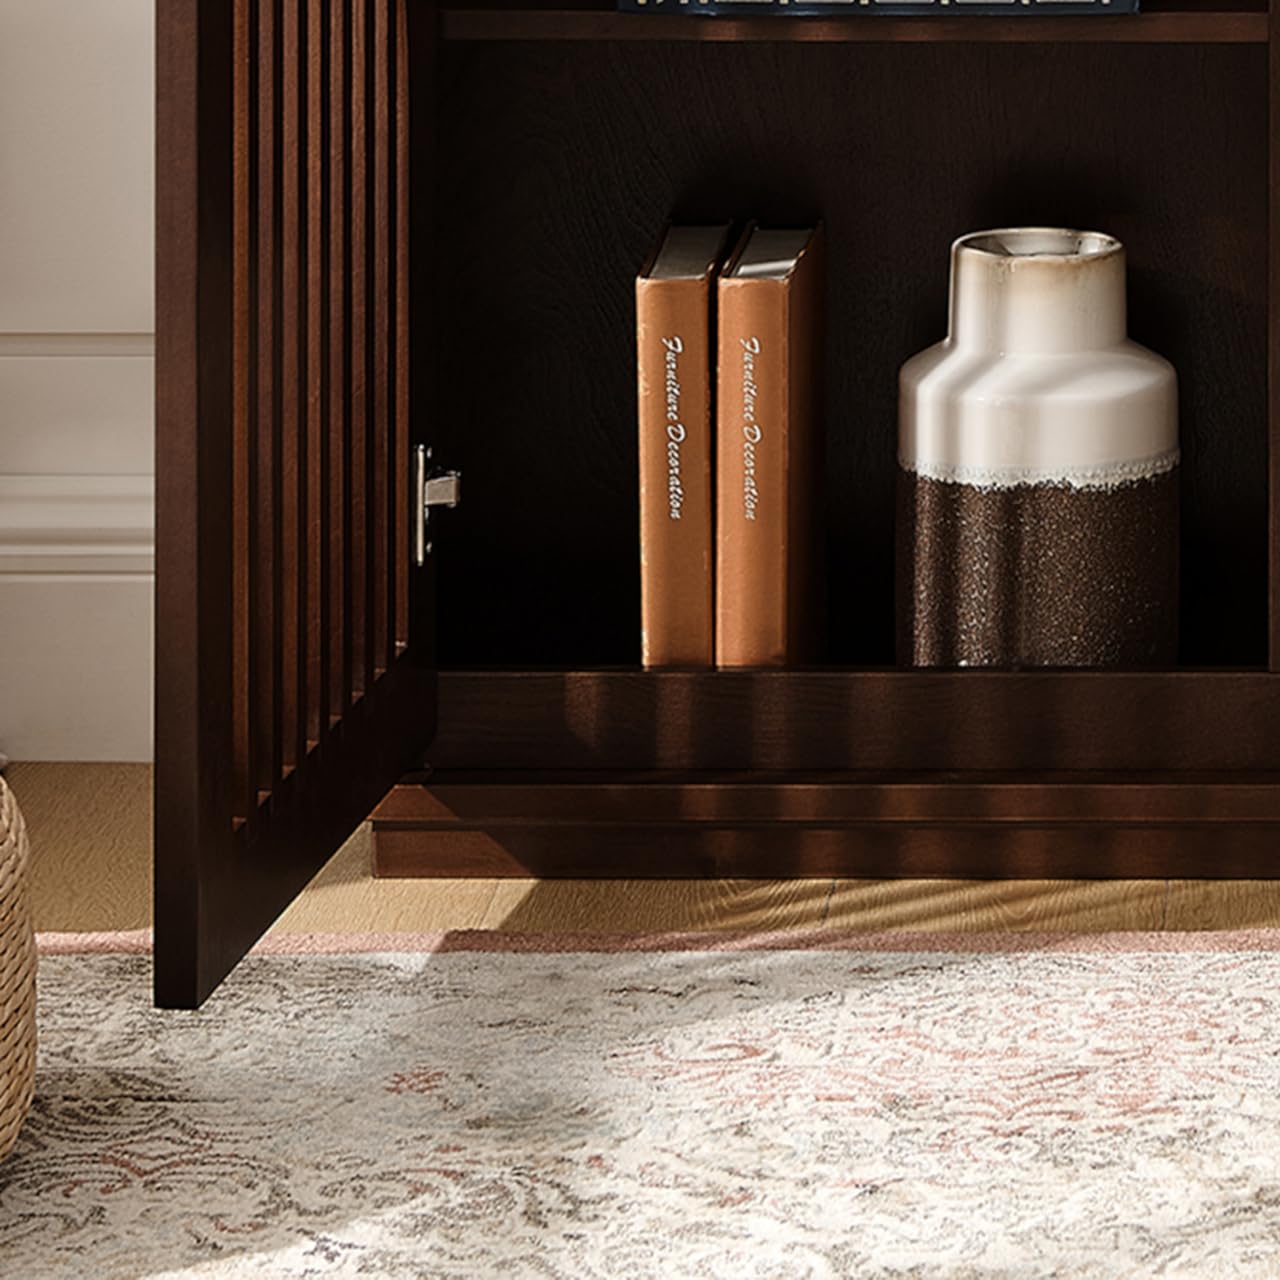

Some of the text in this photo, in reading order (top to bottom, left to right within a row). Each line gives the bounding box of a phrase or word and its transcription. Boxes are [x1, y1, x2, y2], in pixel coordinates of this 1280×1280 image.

[662, 336, 686, 520] Furniture Decoration
[740, 336, 762, 520] Furniture Decoration
